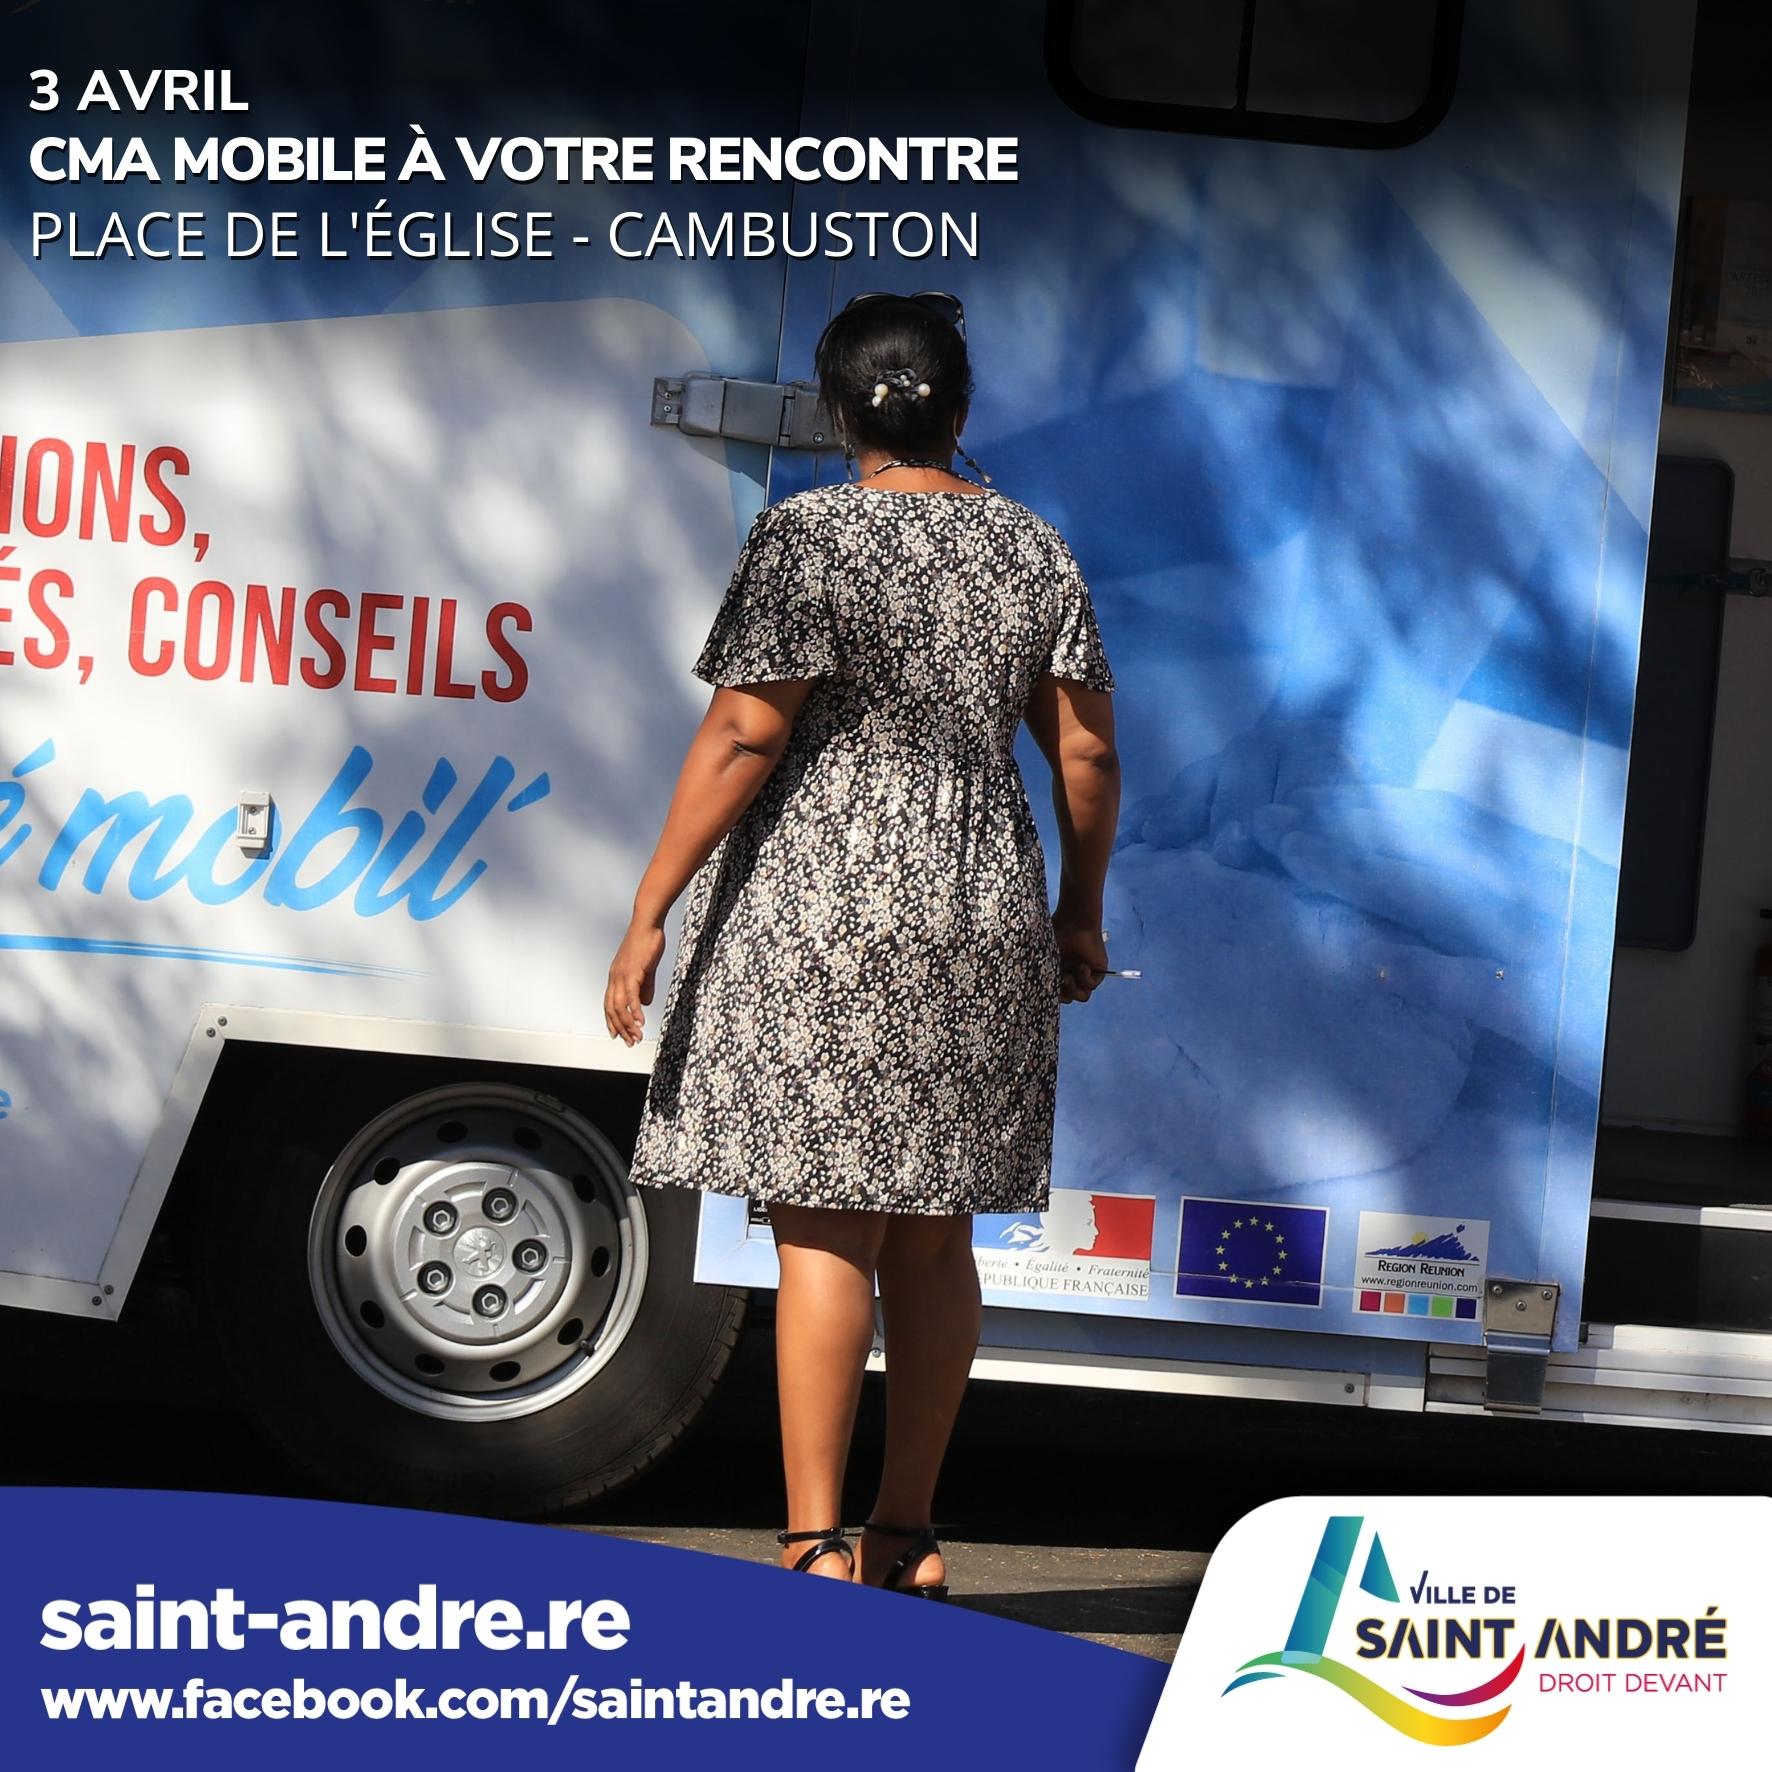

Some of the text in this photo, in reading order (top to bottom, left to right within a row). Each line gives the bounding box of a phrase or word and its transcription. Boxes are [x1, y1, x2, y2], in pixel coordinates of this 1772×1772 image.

[128, 576, 533, 703] CONSEILS
[976, 1256, 1150, 1279] berté Égalité Fraternité
[978, 1269, 1148, 1297] PUBLIQUE FRANÇAISE
[1361, 1276, 1478, 1293] www.regionreunion.com
